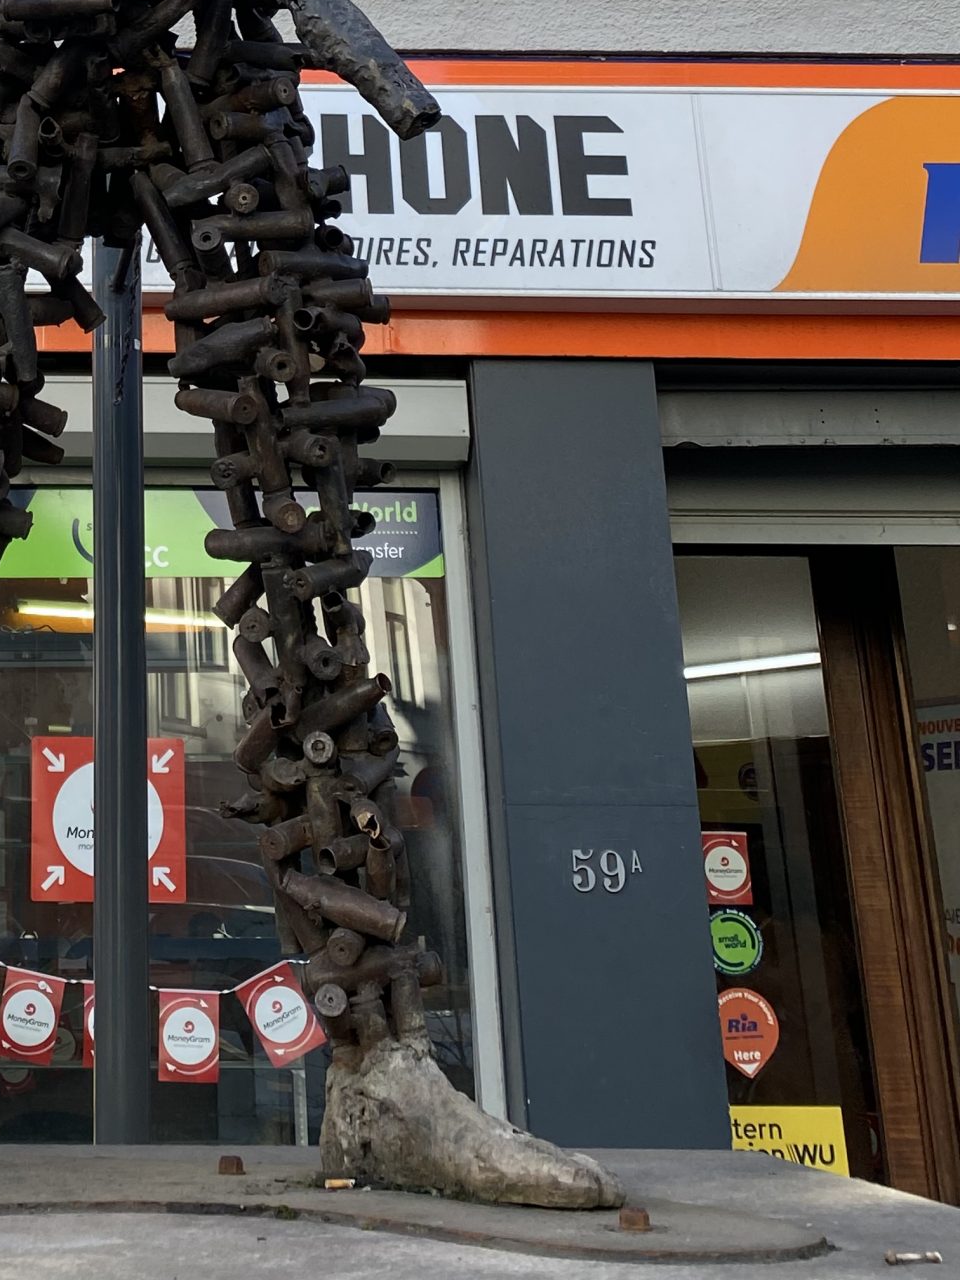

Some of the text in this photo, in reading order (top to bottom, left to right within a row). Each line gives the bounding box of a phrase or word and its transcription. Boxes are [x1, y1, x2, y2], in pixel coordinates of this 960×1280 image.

[452, 238, 657, 269] REPARATIONS
[7, 1013, 50, 1030] MoneyGram
[727, 1013, 758, 1033] Ria
[167, 1034, 211, 1044] MoneyGram
[733, 1050, 762, 1061] Here
